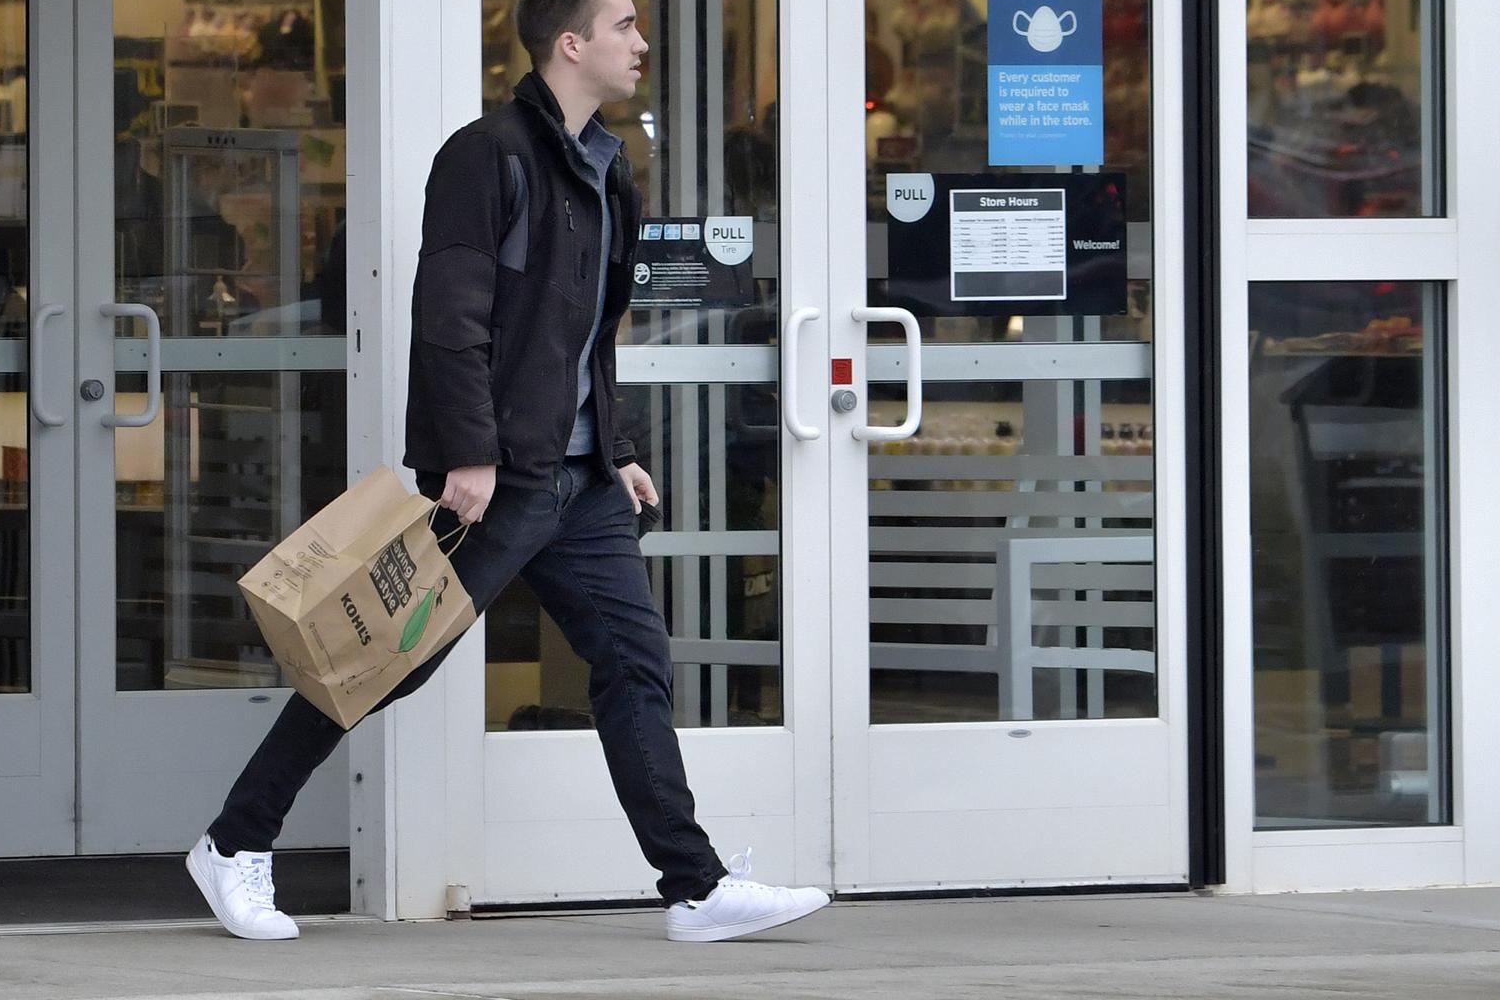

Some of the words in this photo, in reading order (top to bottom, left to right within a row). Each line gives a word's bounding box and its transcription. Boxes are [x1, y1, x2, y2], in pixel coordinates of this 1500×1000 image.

[999, 72, 1029, 85] Every
[1031, 73, 1081, 83] customer
[999, 86, 1008, 97] is
[1010, 86, 1055, 99] required
[1057, 87, 1069, 97] to
[999, 101, 1025, 111] wear
[1027, 102, 1034, 111] a
[1037, 100, 1059, 111] face
[1061, 100, 1089, 111] mask
[999, 115, 1028, 126] while
[1030, 115, 1040, 126] in
[1043, 115, 1060, 126] the
[1063, 116, 1093, 126] store.
[895, 189, 927, 201] PULL
[979, 197, 1006, 208] Store
[1008, 197, 1038, 207] Hours
[712, 228, 745, 239] PULL
[721, 246, 737, 254] Tire
[1073, 239, 1120, 250] Welcome!
[387, 563, 410, 604] always
[341, 593, 372, 646] KOHL'S
